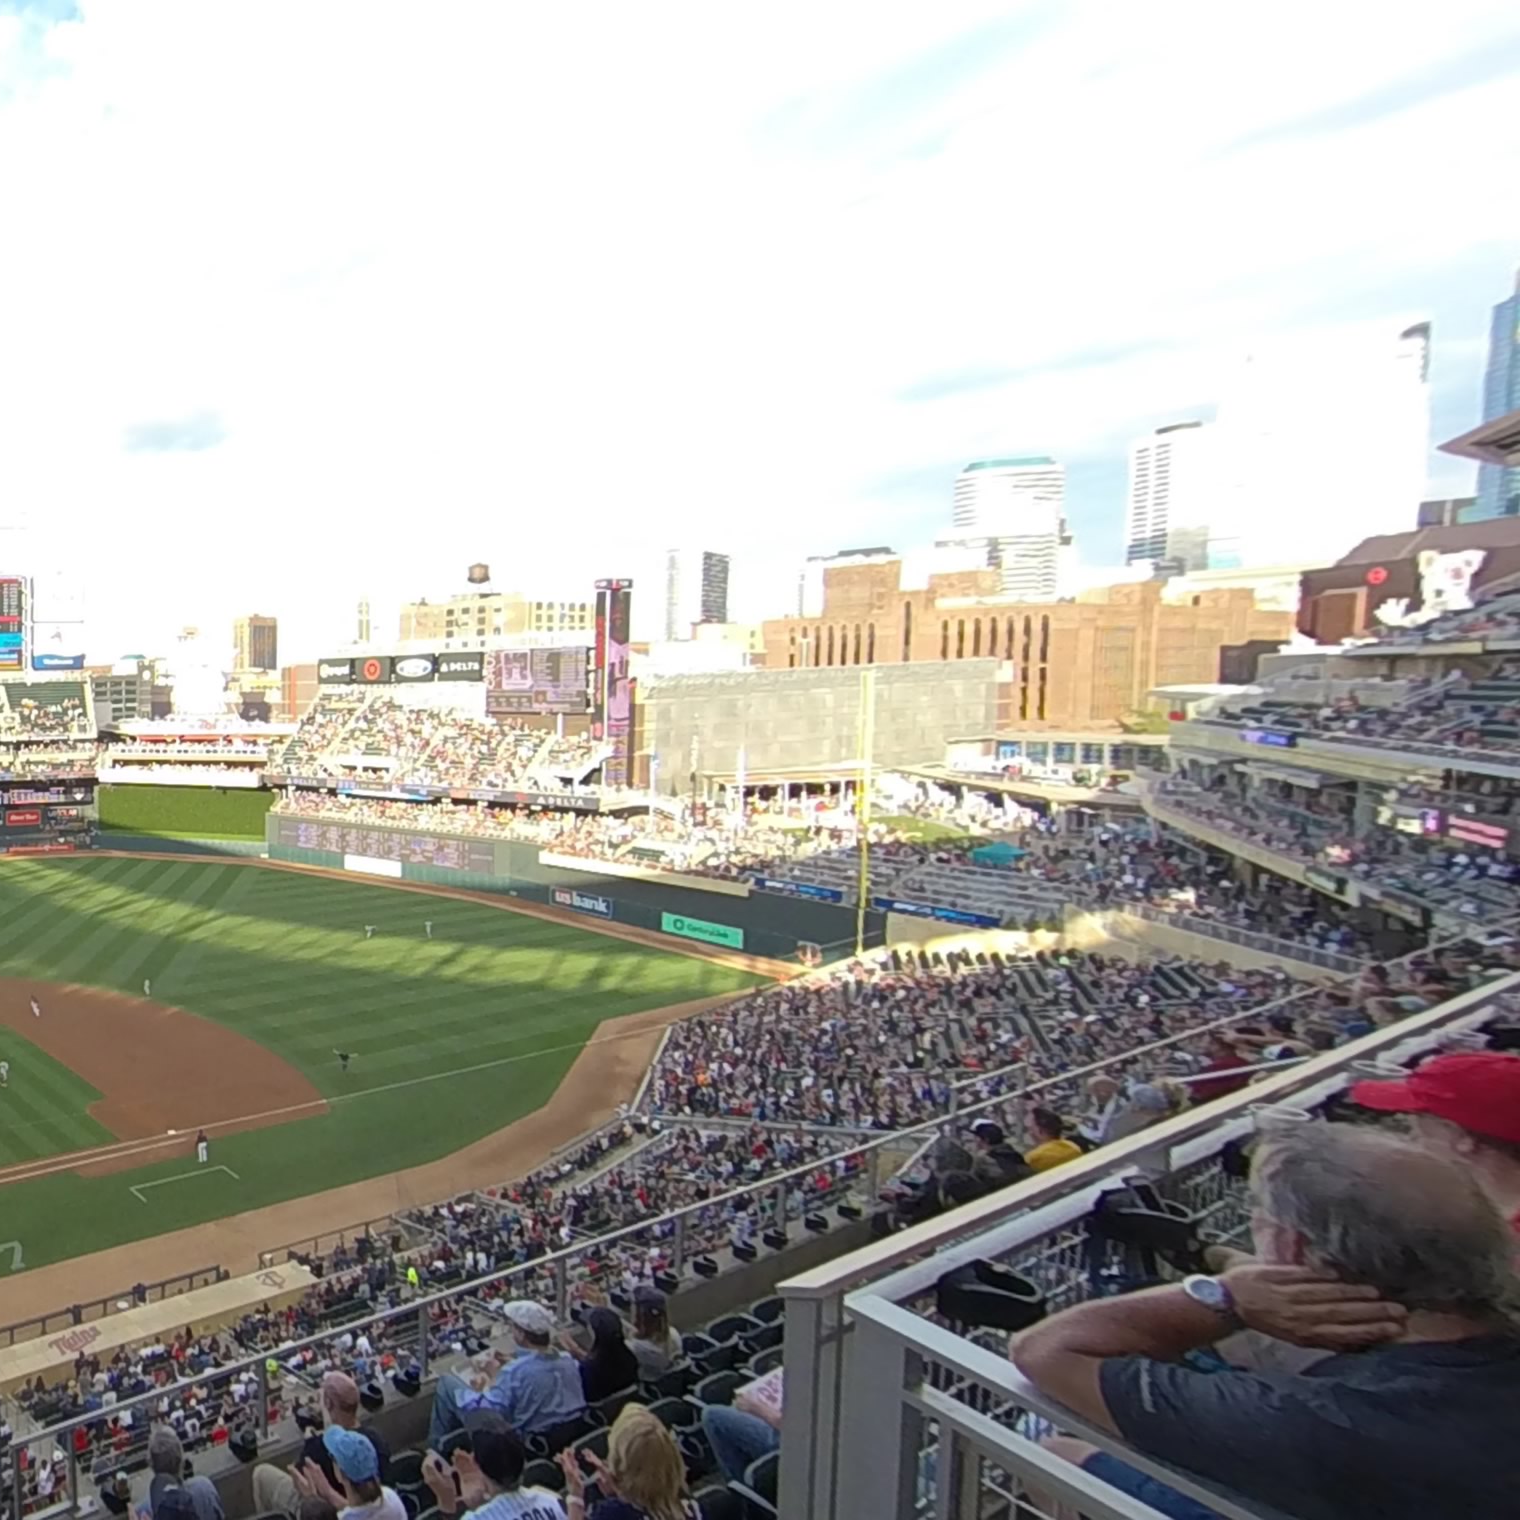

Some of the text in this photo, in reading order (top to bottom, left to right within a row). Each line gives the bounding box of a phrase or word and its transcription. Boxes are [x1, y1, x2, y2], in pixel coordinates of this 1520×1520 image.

[449, 661, 480, 671] DELTA
[547, 797, 585, 807] DELTA
[47, 1324, 102, 1356] Twins
